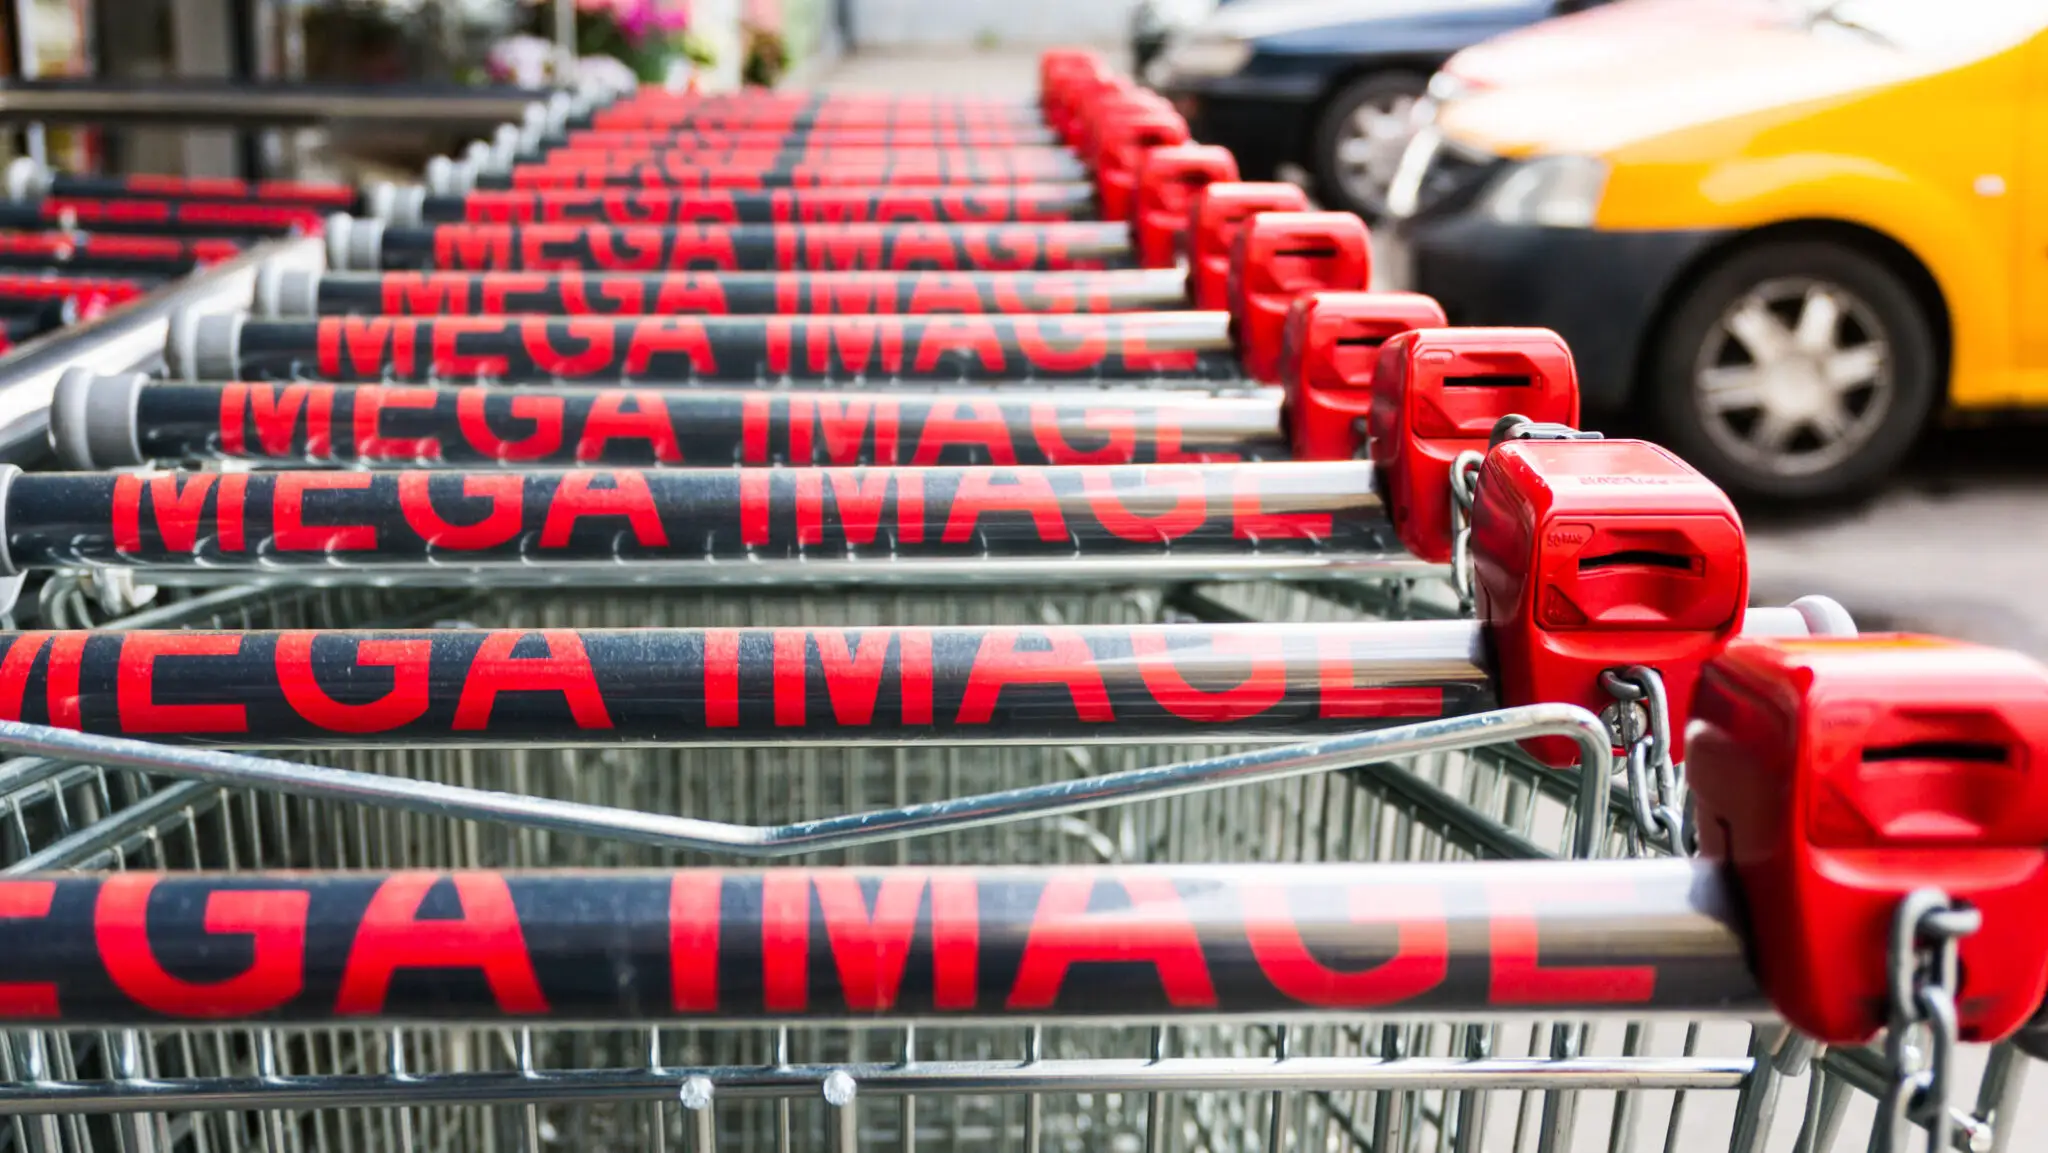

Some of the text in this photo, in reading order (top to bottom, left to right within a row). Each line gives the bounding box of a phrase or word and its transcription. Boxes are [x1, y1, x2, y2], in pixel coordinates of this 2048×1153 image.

[434, 224, 738, 271] MEGA
[381, 271, 730, 316] MEGA
[317, 313, 1197, 376] MEGA IMAGE
[219, 382, 1240, 466] MEGA IMAGE
[112, 464, 1334, 551] MEGA IMAGE
[704, 625, 1444, 729] IMAGE
[669, 866, 1657, 1014] IMAGE
